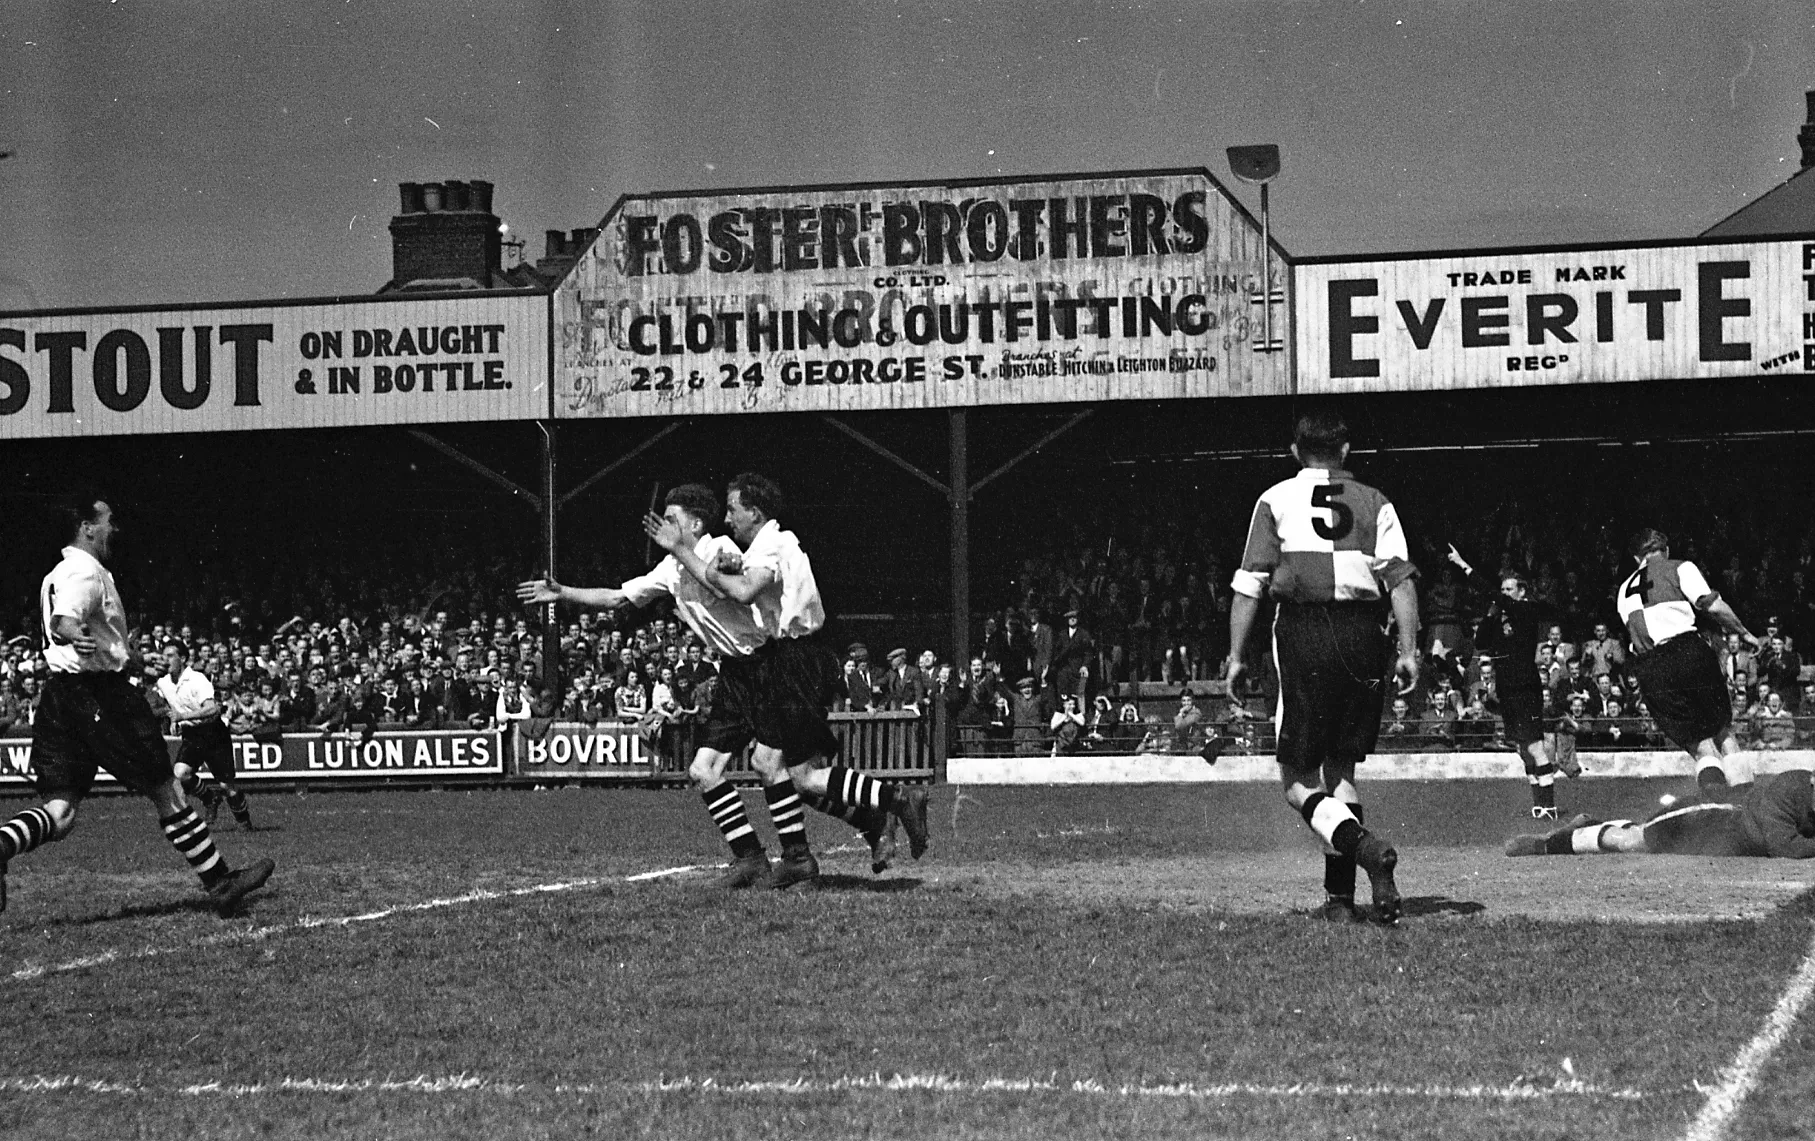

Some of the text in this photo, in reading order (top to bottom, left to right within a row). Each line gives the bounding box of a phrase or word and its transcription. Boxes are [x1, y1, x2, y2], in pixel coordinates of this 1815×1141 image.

[624, 191, 1208, 276] FOSTER BROTHERS
[873, 275, 950, 288] CO. LTD.
[1447, 265, 1626, 287] TRADE MARK
[628, 309, 863, 356] CLOTHING
[875, 319, 897, 347] &
[904, 294, 1209, 345] OUTFITTING
[1328, 261, 1752, 378] EVERITE
[299, 325, 506, 359] ON DRAUGHT
[0, 323, 274, 415] STOUT
[631, 366, 674, 391] 22
[719, 363, 765, 389] 24
[780, 357, 926, 387] GEORGE
[943, 354, 988, 380] ST.
[999, 363, 1058, 379] DUNSTABLE
[1063, 359, 1107, 374] HITCHIN
[1117, 357, 1166, 373] LEIGHTON
[1760, 350, 1800, 370] WITH
[294, 361, 513, 395] & IN BOTTLE.
[1311, 484, 1354, 541] 5
[1625, 566, 1654, 604] 4
[414, 738, 490, 766] ALES
[528, 734, 649, 763] BOVRIL
